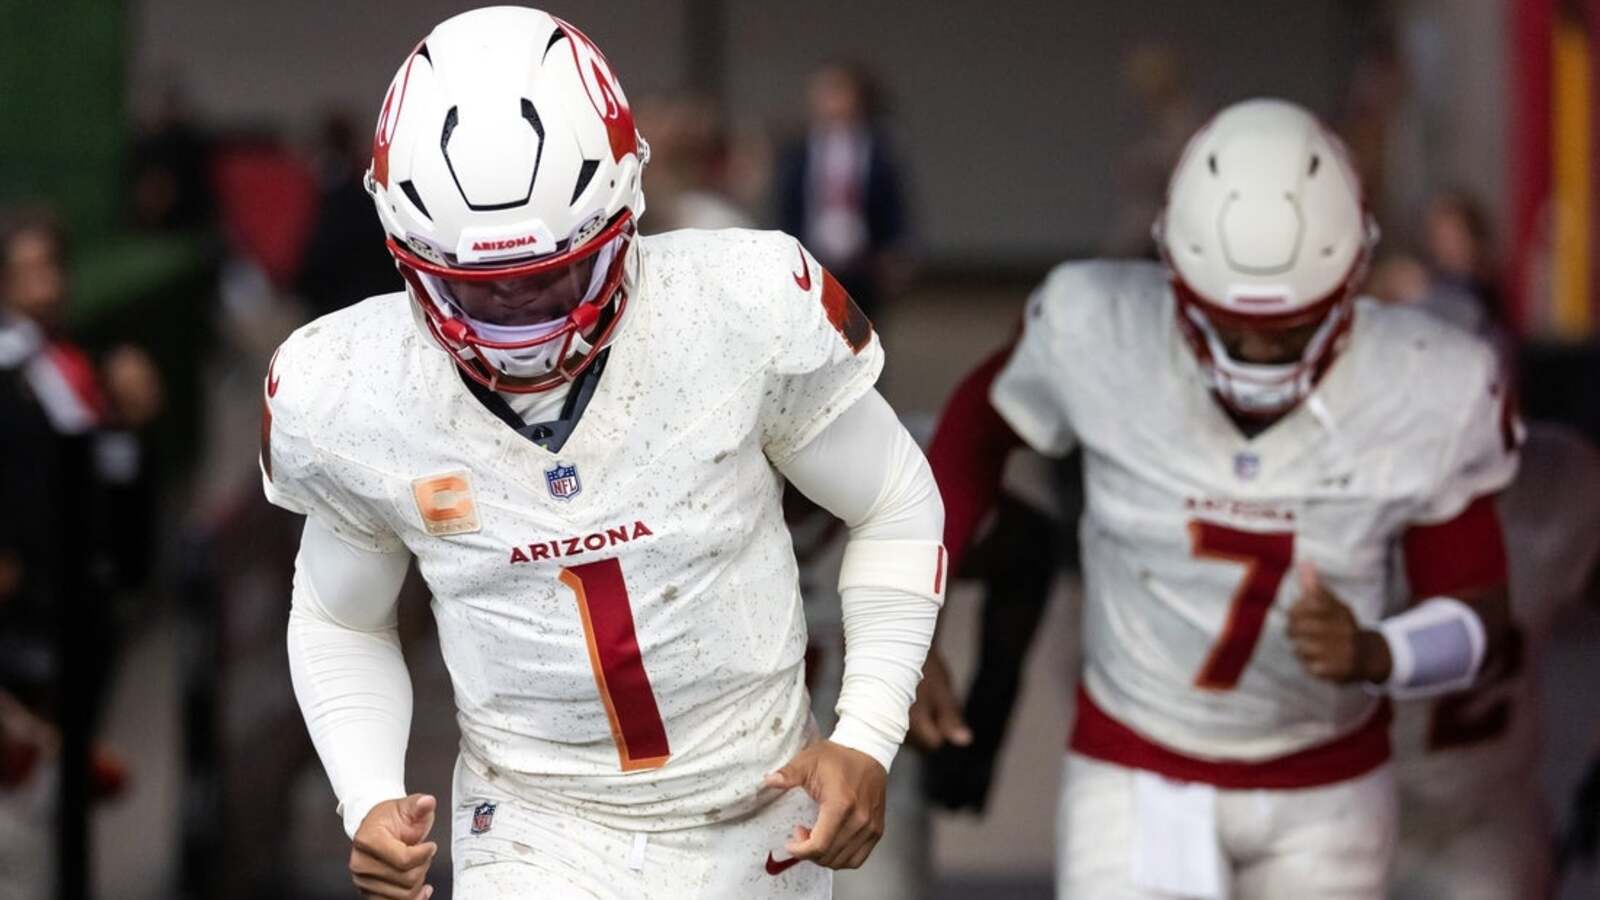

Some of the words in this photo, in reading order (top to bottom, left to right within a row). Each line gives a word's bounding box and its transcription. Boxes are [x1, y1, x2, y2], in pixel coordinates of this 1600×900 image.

[472, 235, 537, 251] ARIZONA
[415, 476, 471, 522] C
[552, 478, 577, 495] NFL
[510, 521, 653, 564] ARIZONA
[1188, 519, 1295, 693] 7
[558, 557, 671, 772] 1
